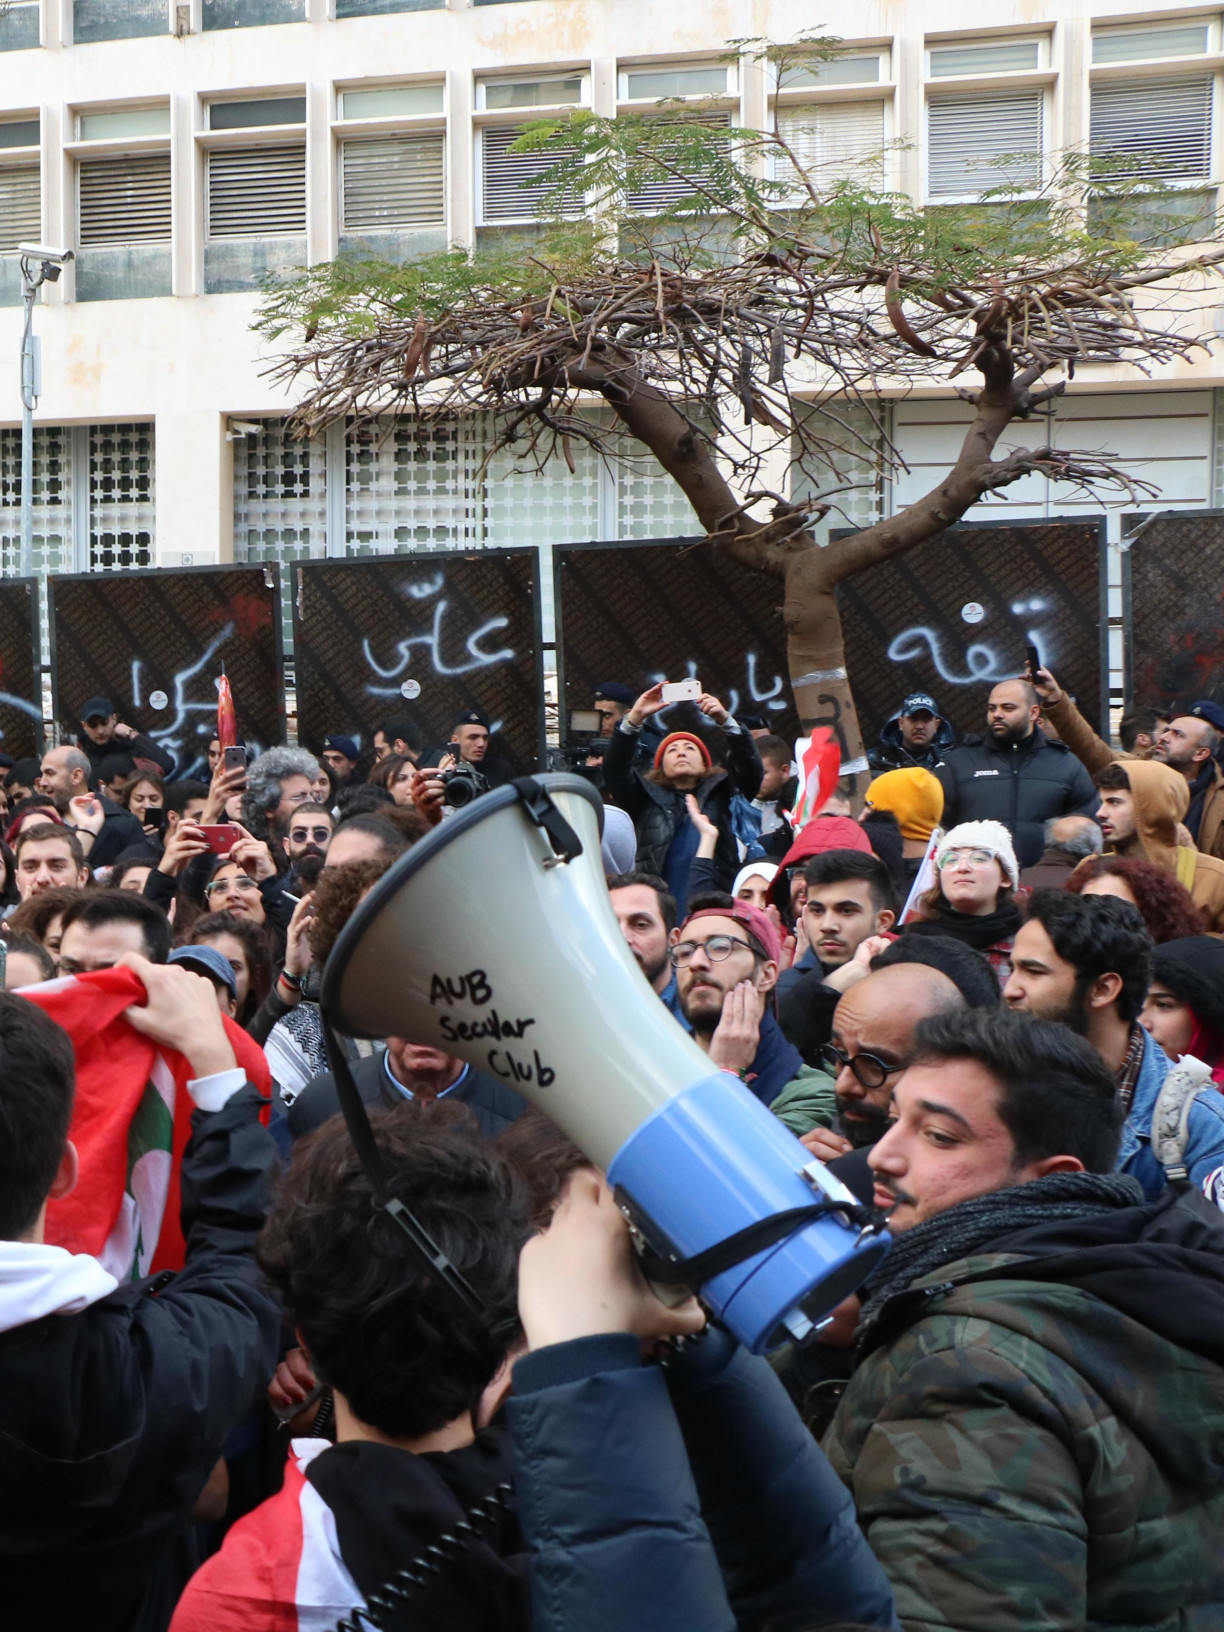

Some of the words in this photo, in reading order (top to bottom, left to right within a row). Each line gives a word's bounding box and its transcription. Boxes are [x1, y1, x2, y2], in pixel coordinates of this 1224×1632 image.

[429, 969, 493, 1006] AUB
[438, 1009, 536, 1043] Secular
[487, 1049, 556, 1088] Club
